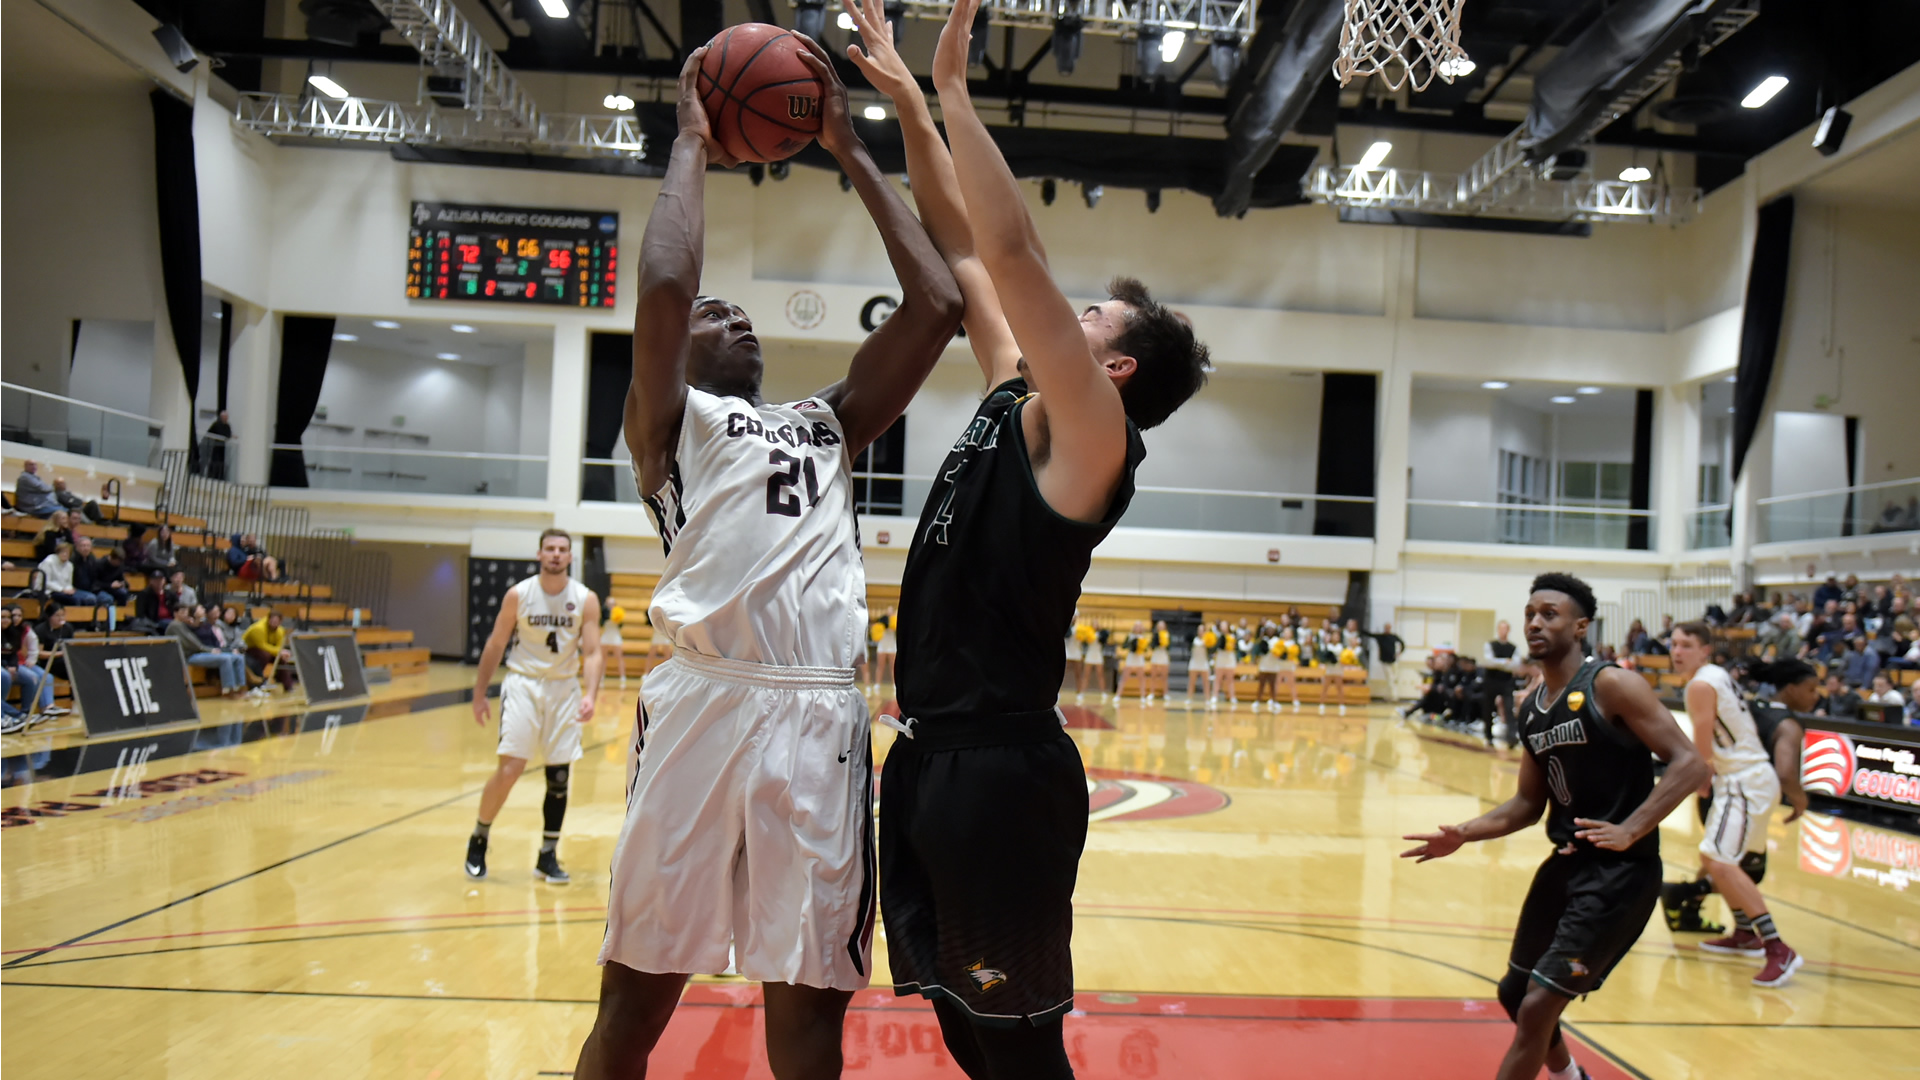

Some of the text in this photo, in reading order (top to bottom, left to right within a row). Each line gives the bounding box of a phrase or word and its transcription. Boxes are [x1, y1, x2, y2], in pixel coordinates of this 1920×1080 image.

[437, 209, 479, 223] AZUSA
[481, 212, 528, 226] PACIFIC
[529, 214, 591, 229] COUGARS
[458, 244, 480, 264] 72
[496, 238, 509, 255] 4
[549, 249, 571, 269] 56
[727, 412, 840, 447] COUGARS
[766, 447, 821, 517] 21
[528, 614, 573, 628] COUGARS
[546, 631, 559, 653] 4
[104, 656, 160, 717] THE
[1853, 768, 1920, 804] COUGA
